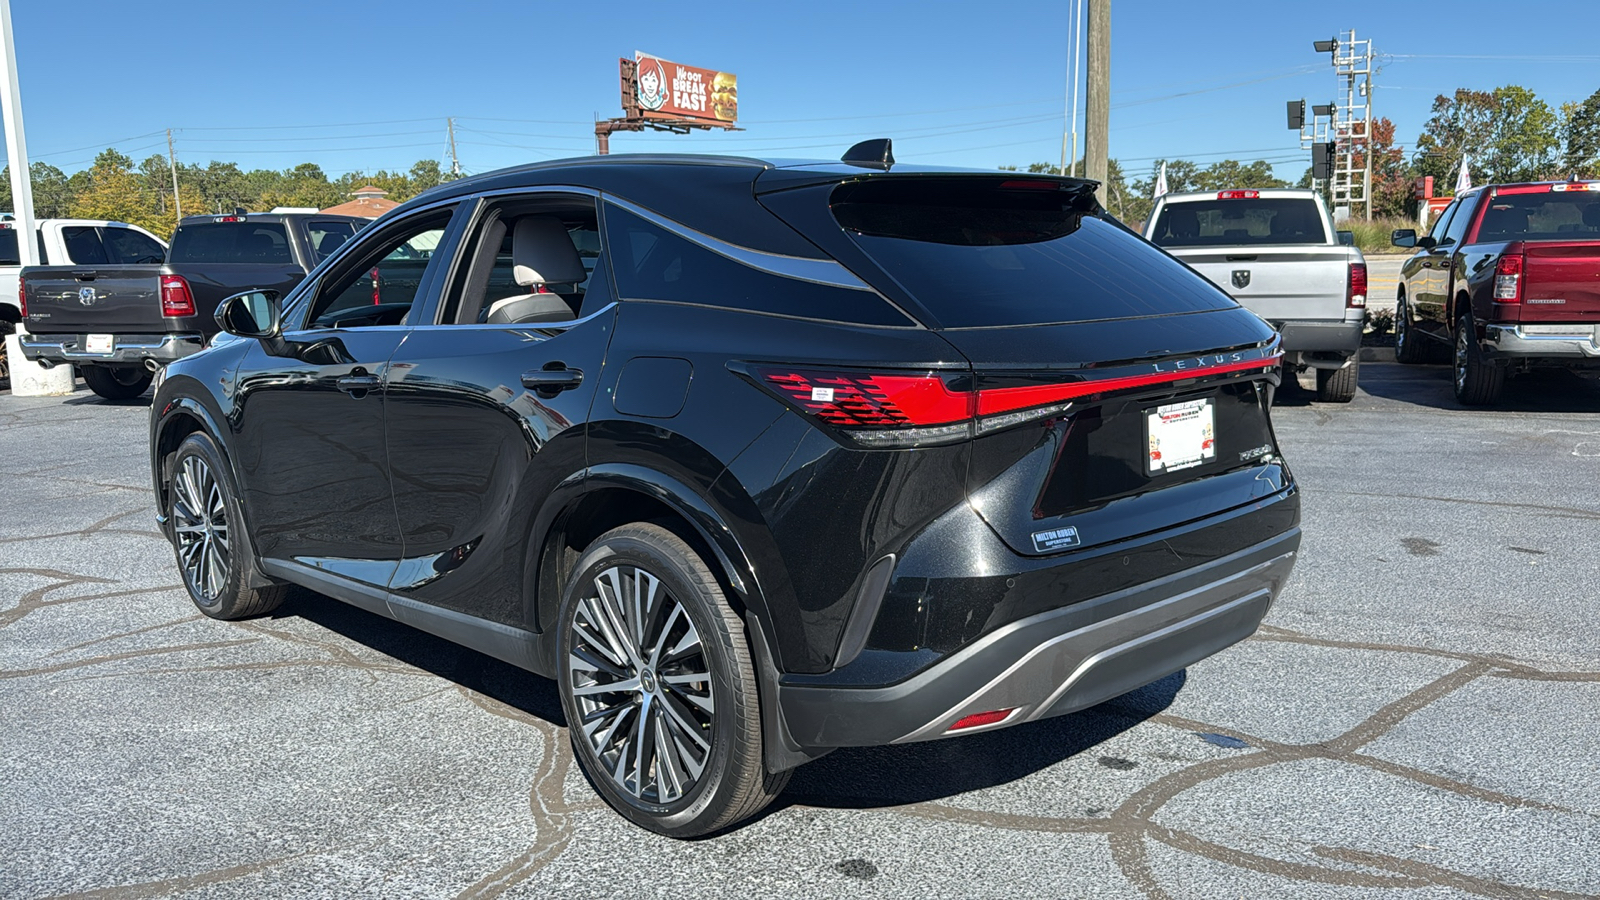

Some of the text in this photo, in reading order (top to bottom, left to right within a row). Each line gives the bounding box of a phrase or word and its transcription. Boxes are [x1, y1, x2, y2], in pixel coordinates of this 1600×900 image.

[672, 78, 706, 95] BREAK
[673, 91, 707, 111] FAST
[1152, 353, 1241, 372] LEXUS
[1035, 531, 1057, 542] MILTON
